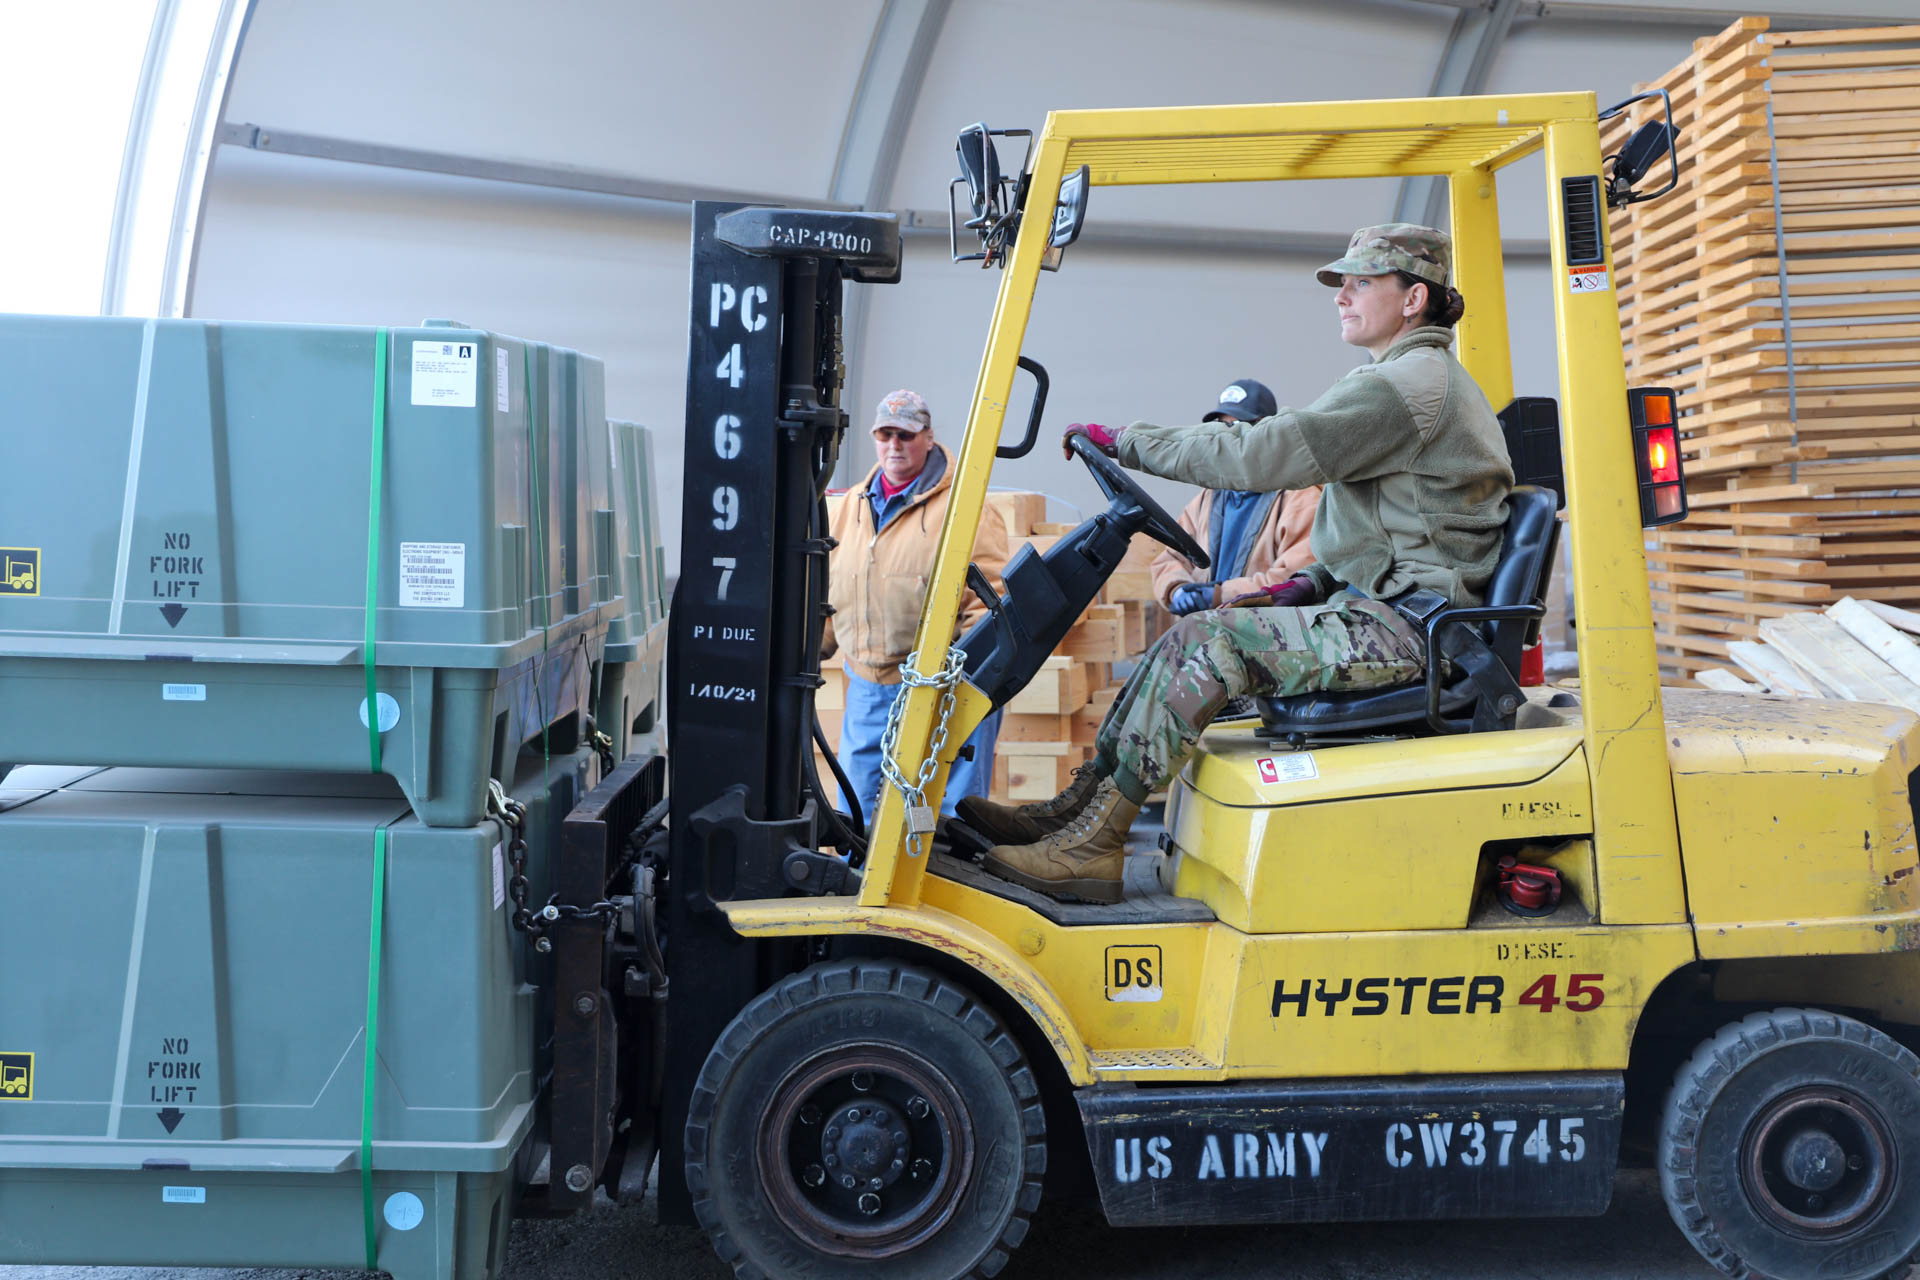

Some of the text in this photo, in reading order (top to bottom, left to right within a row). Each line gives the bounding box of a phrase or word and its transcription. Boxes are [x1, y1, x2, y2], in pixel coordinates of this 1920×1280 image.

[770, 225, 810, 244] CAP
[710, 283, 767, 332] PC
[164, 532, 190, 549] NO
[150, 556, 203, 574] FORK
[154, 580, 199, 598] LIFT
[722, 627, 756, 641] DUE
[1114, 957, 1153, 988] DS
[1271, 974, 1606, 1018] HYSTER 45
[162, 1038, 188, 1055] NO
[148, 1061, 201, 1079] FORK
[151, 1086, 197, 1103] LIFT
[1115, 1117, 1586, 1183] US ARMY CW3745
